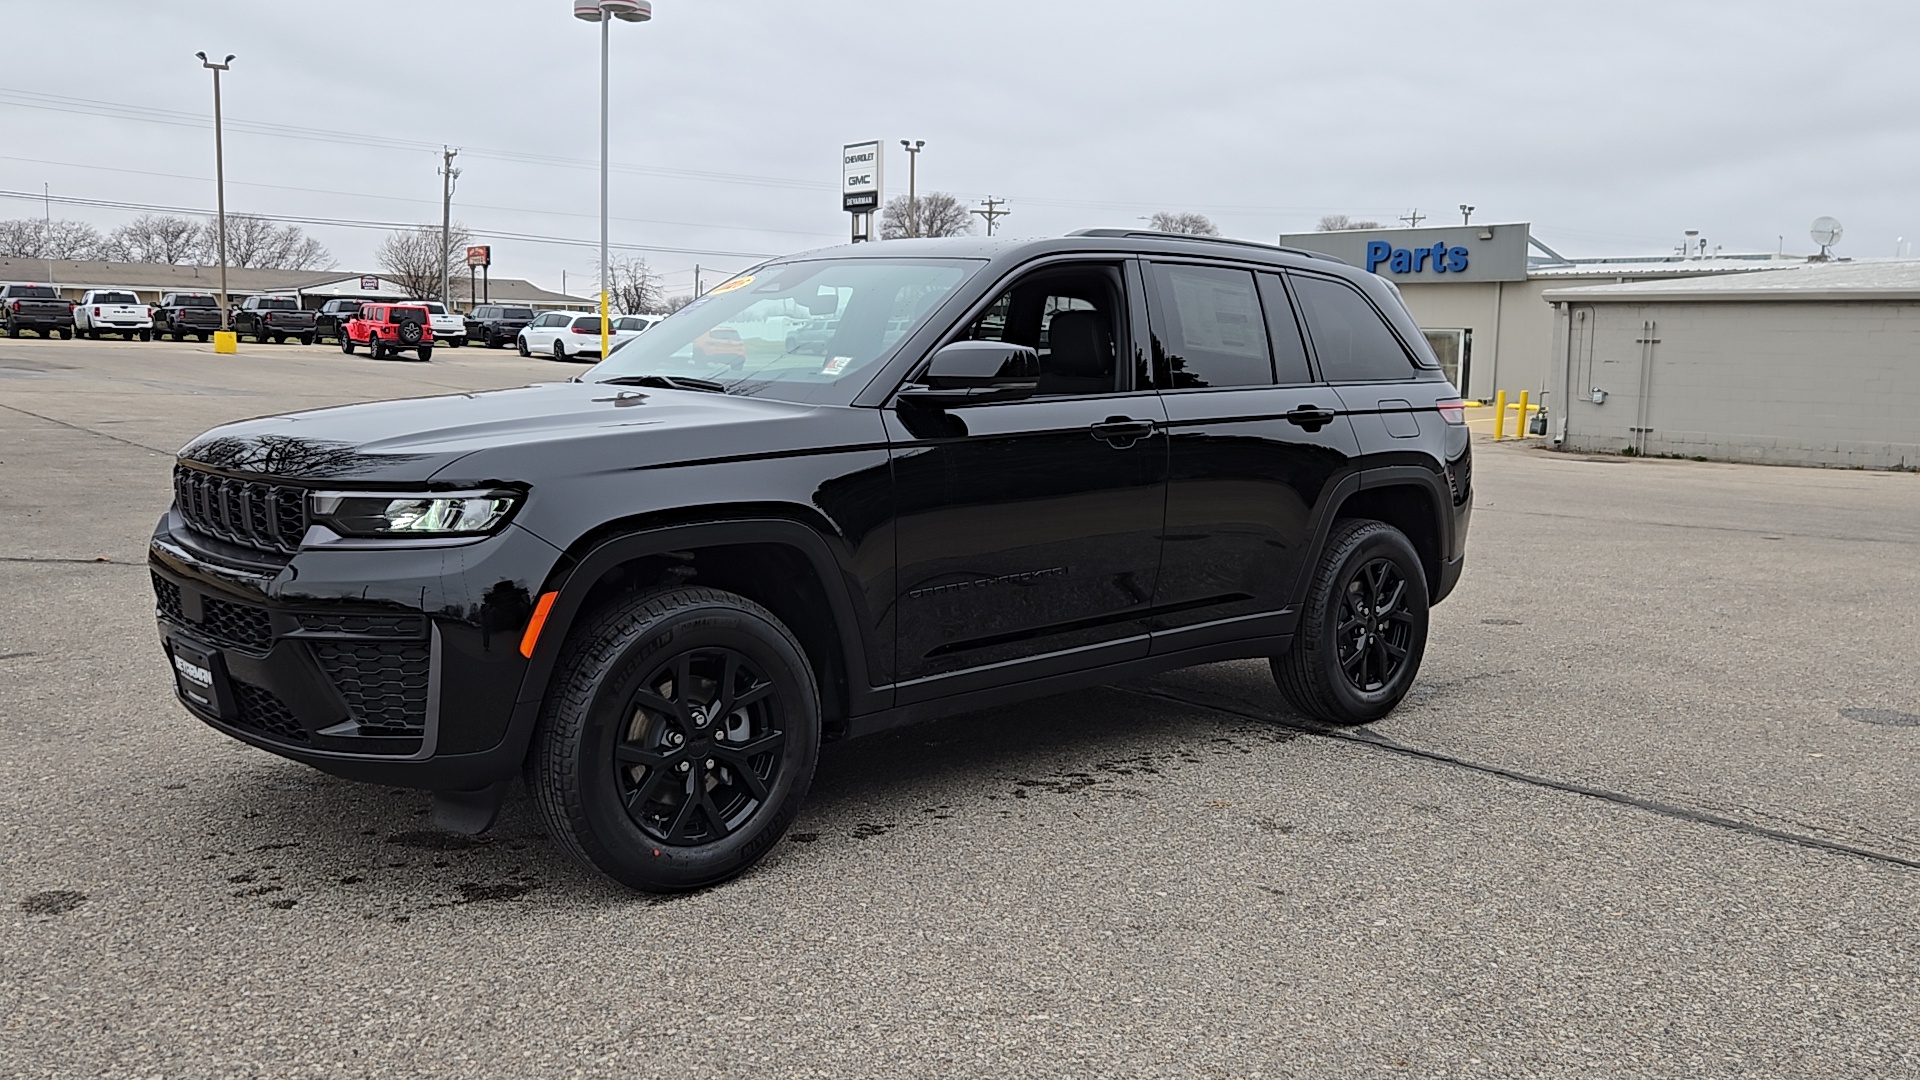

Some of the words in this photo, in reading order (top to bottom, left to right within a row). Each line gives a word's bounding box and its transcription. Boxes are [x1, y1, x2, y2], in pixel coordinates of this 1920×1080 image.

[845, 153, 874, 164] CHEVROLET
[848, 175, 870, 186] GMC
[1366, 241, 1468, 273] Parts
